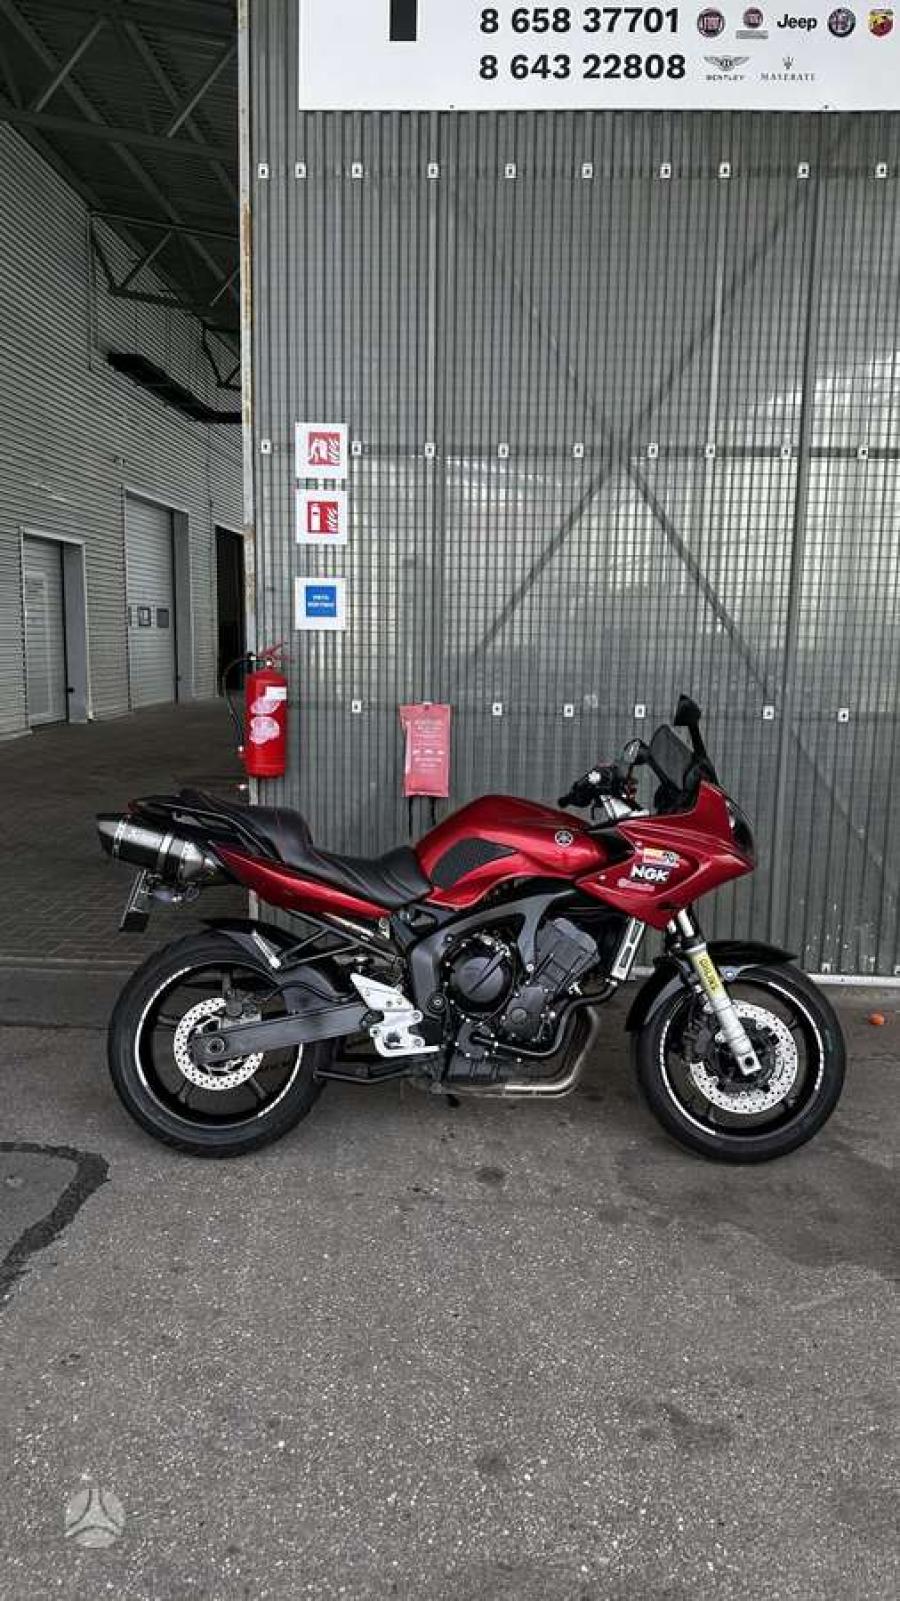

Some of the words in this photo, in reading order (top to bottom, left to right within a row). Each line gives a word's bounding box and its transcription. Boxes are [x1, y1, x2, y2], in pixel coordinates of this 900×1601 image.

[479, 8, 499, 34] 8
[511, 7, 571, 33] 658
[582, 6, 679, 33] 37701
[776, 13, 818, 32] Jeep
[479, 54, 499, 81] 8
[510, 54, 570, 80] 643
[582, 53, 686, 79] 22808
[631, 863, 670, 882] NGK
